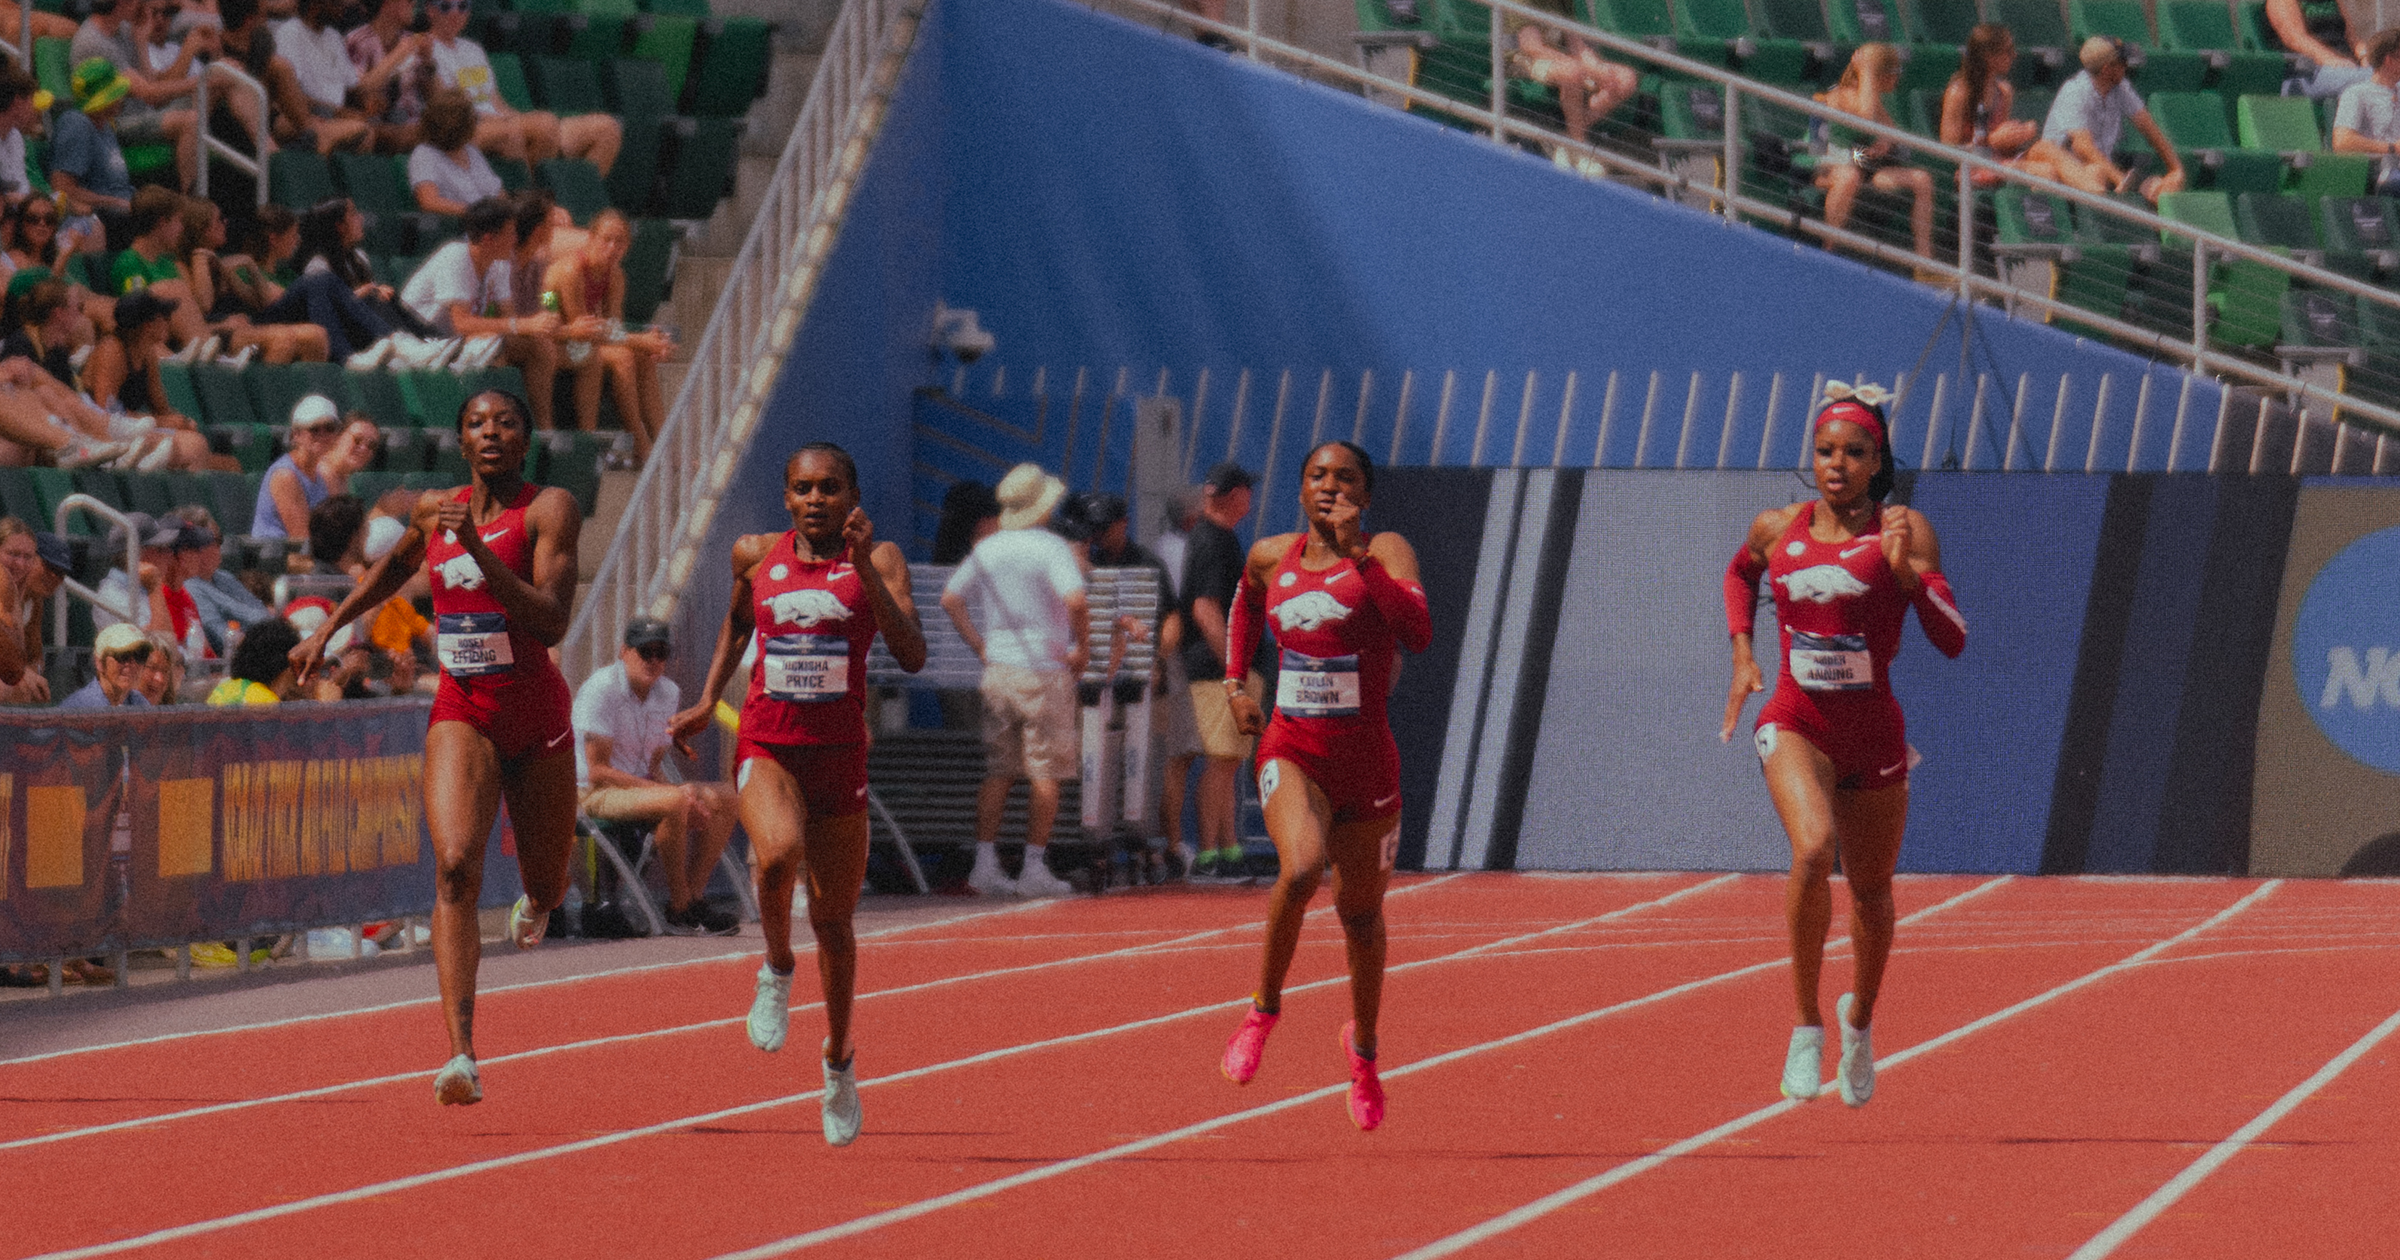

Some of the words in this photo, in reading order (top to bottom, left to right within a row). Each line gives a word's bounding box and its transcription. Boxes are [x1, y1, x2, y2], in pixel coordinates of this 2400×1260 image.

[452, 649, 497, 664] EFFIONG
[786, 674, 825, 688] PRYCE
[1295, 690, 1340, 704] BROWN
